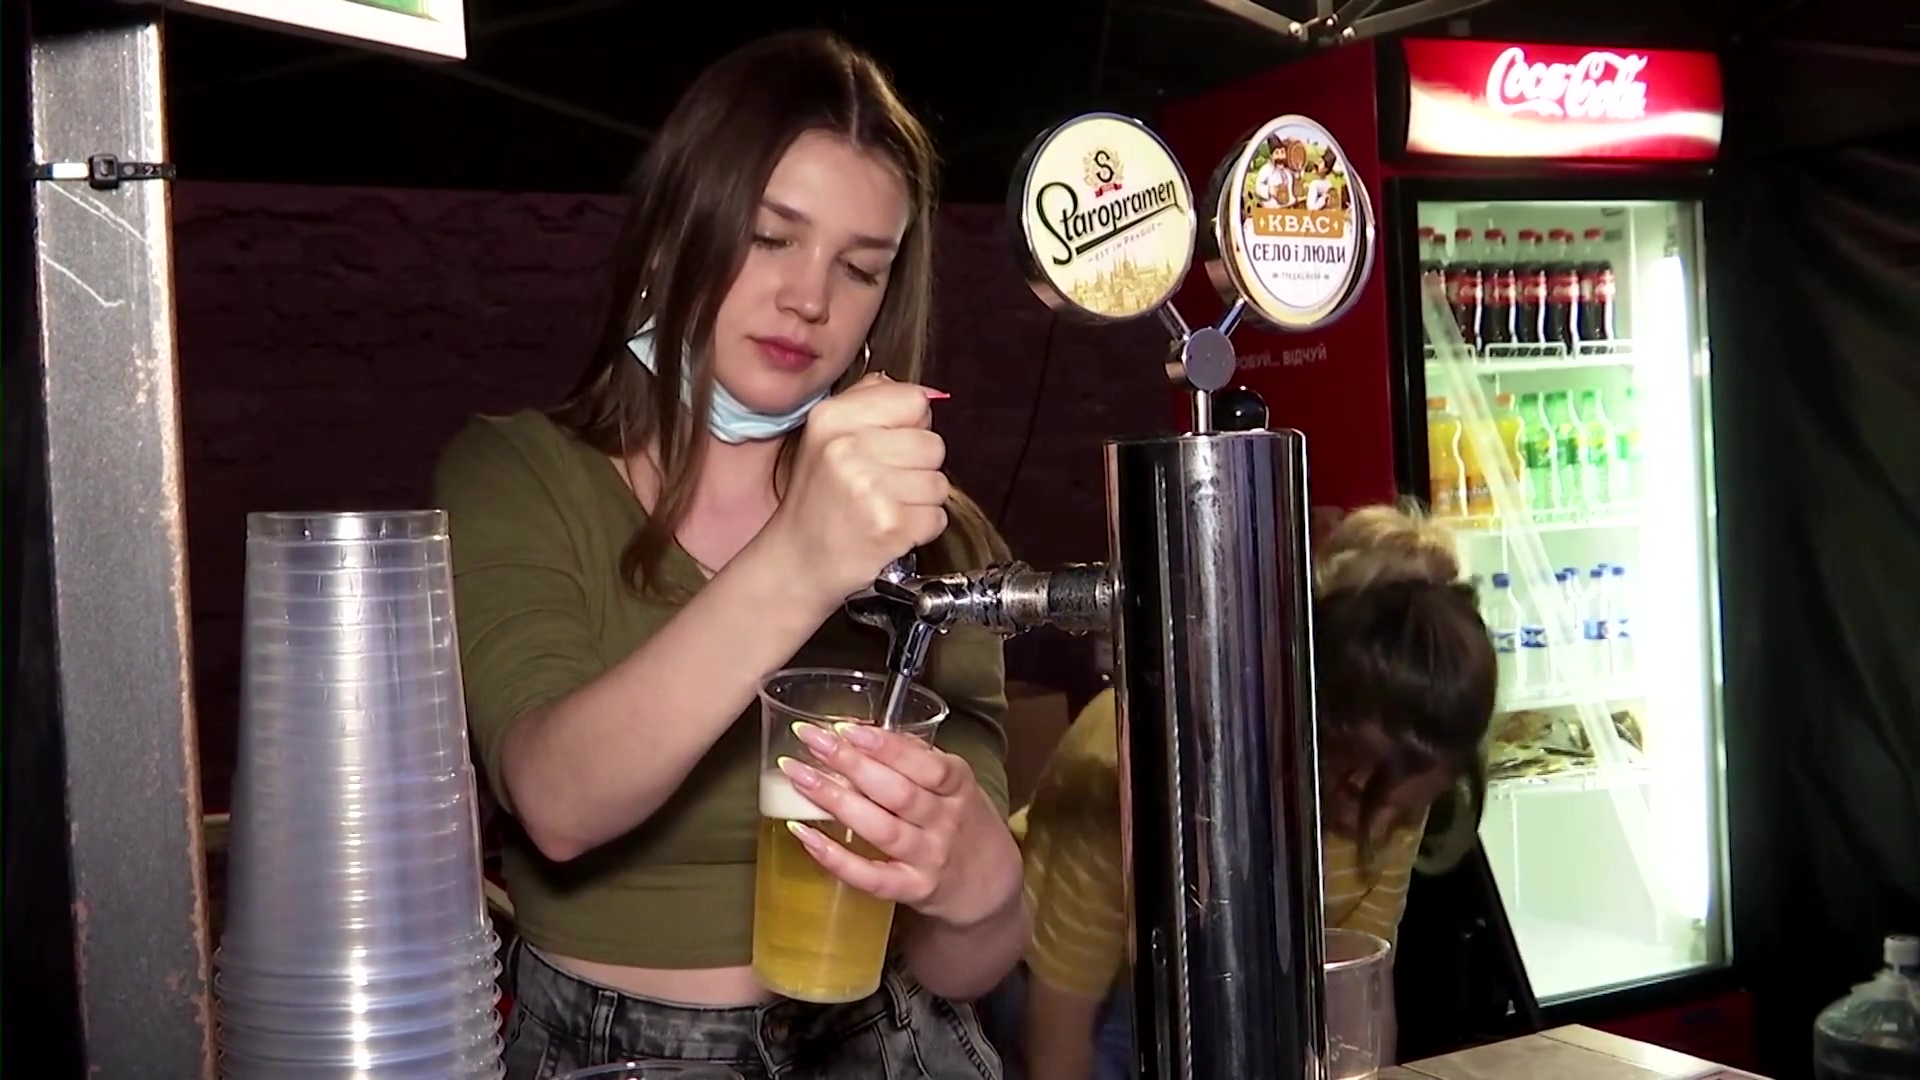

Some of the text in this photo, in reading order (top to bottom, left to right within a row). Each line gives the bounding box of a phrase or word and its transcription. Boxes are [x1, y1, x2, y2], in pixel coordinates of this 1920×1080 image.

[1486, 47, 1648, 118] Coca-Cola
[1036, 179, 1186, 266] Staropramen
[1267, 214, 1331, 233] КВАС
[1252, 243, 1292, 263] СЕЛО
[1301, 244, 1347, 264] ЛЮДИ
